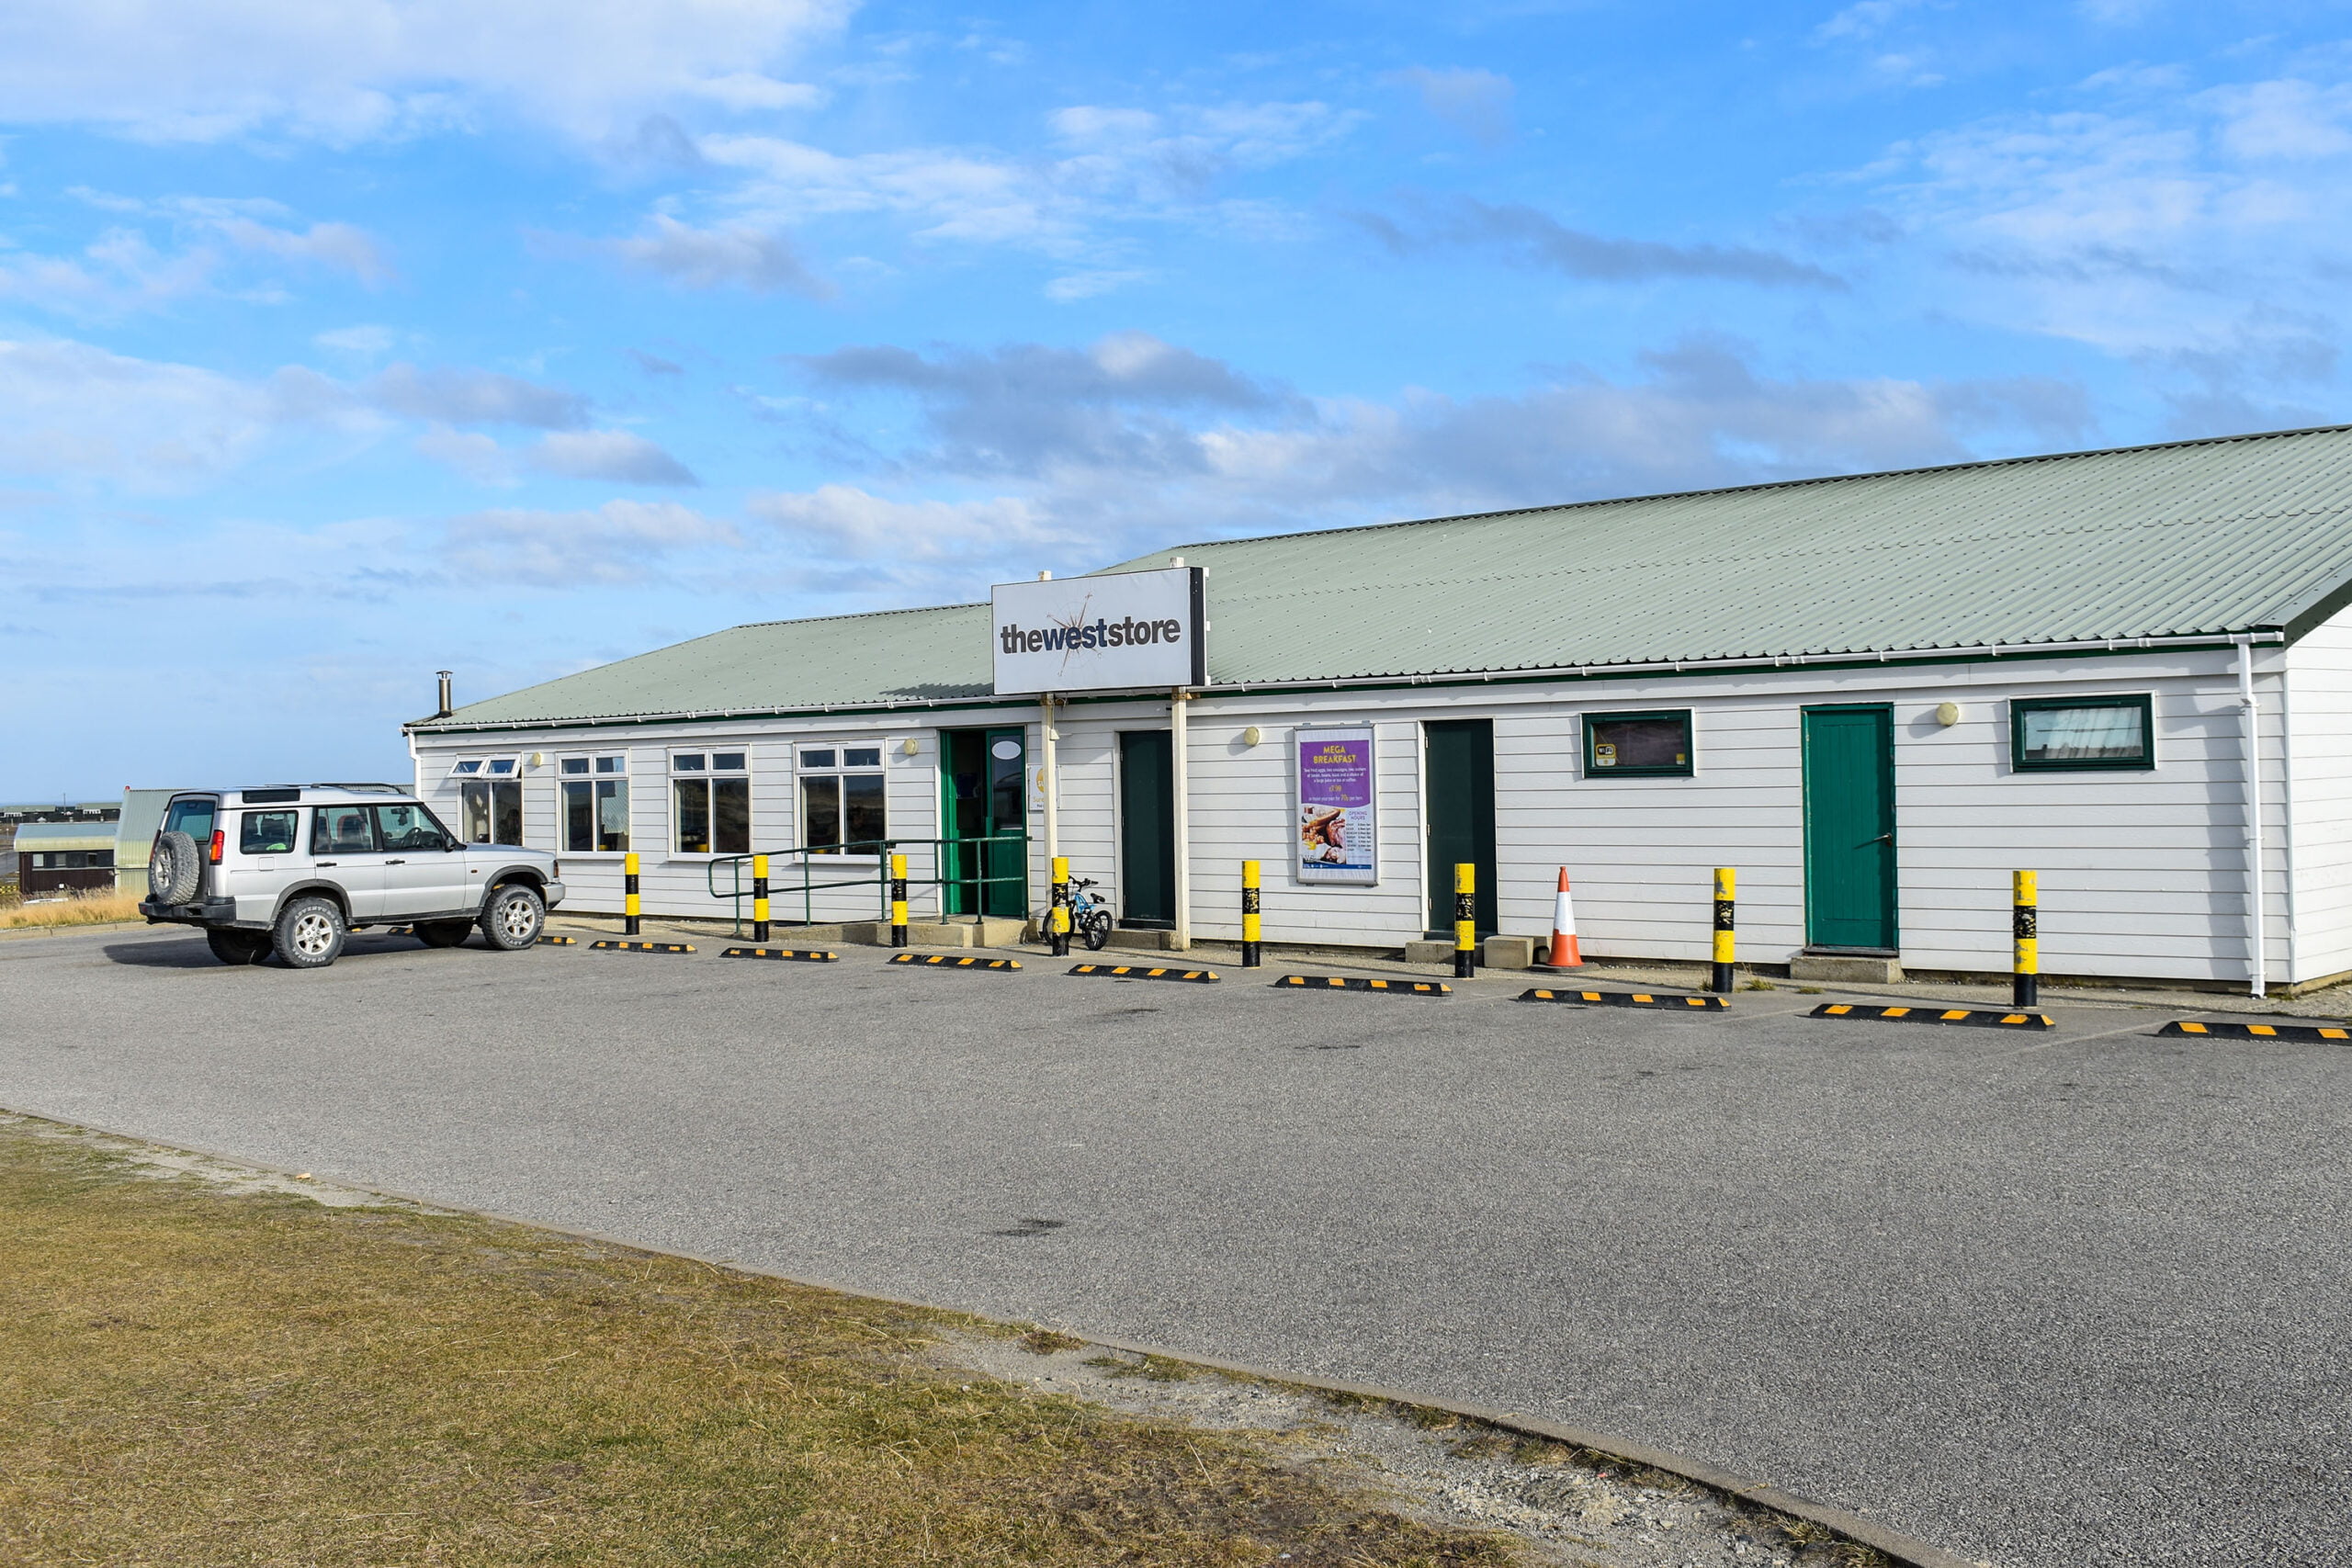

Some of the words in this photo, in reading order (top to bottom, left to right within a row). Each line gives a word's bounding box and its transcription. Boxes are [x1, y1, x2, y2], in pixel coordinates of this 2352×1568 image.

[1001, 616, 1181, 654] theweststore
[1323, 745, 1345, 753] MEGA
[1313, 754, 1356, 763] BREAKFAST
